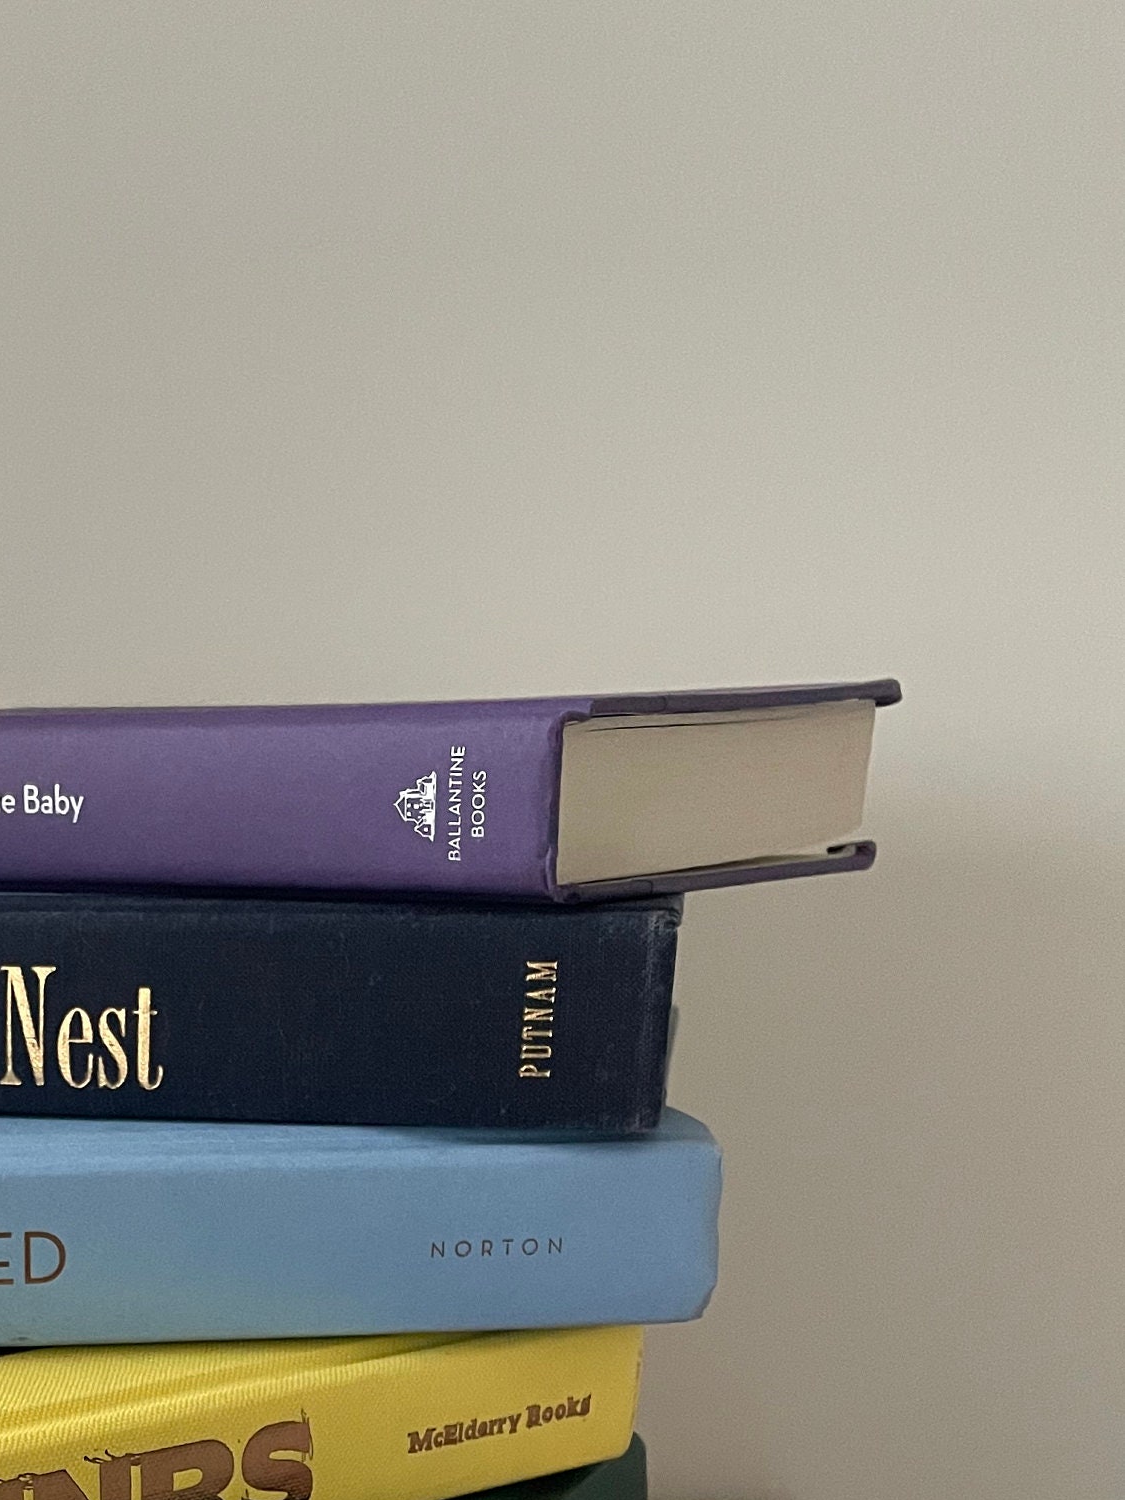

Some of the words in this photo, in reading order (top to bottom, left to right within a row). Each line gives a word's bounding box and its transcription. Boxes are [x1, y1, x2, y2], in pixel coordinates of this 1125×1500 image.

[23, 784, 85, 823] Baby
[448, 745, 466, 861] BALLANTINE
[471, 770, 487, 838] BOOKS
[0, 965, 164, 1090] Nest
[518, 960, 558, 1078] PUTNAM
[430, 1237, 563, 1259] NORTON
[526, 1392, 592, 1429] Books
